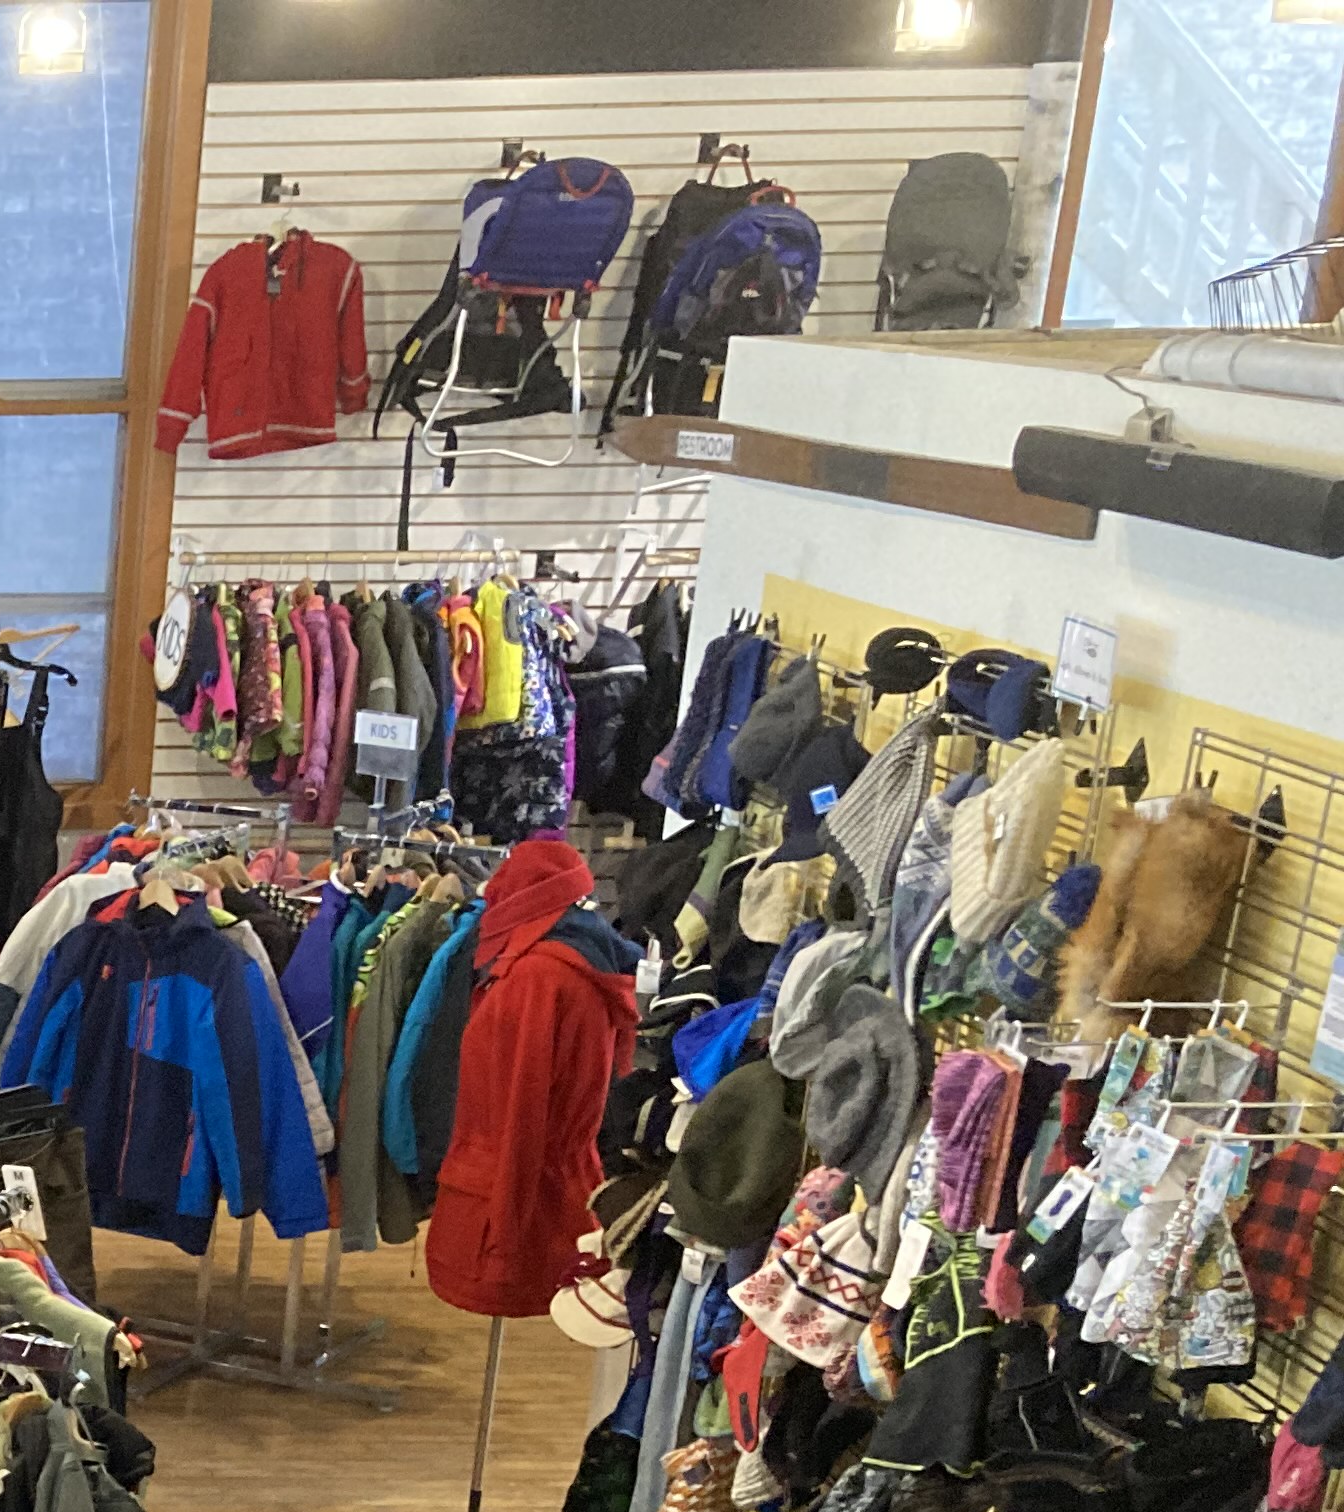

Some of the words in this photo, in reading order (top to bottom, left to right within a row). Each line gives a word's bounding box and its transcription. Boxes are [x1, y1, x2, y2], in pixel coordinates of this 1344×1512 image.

[679, 435, 733, 457] RESTROOM
[158, 613, 186, 666] KIDS
[370, 723, 398, 740] KIDS
